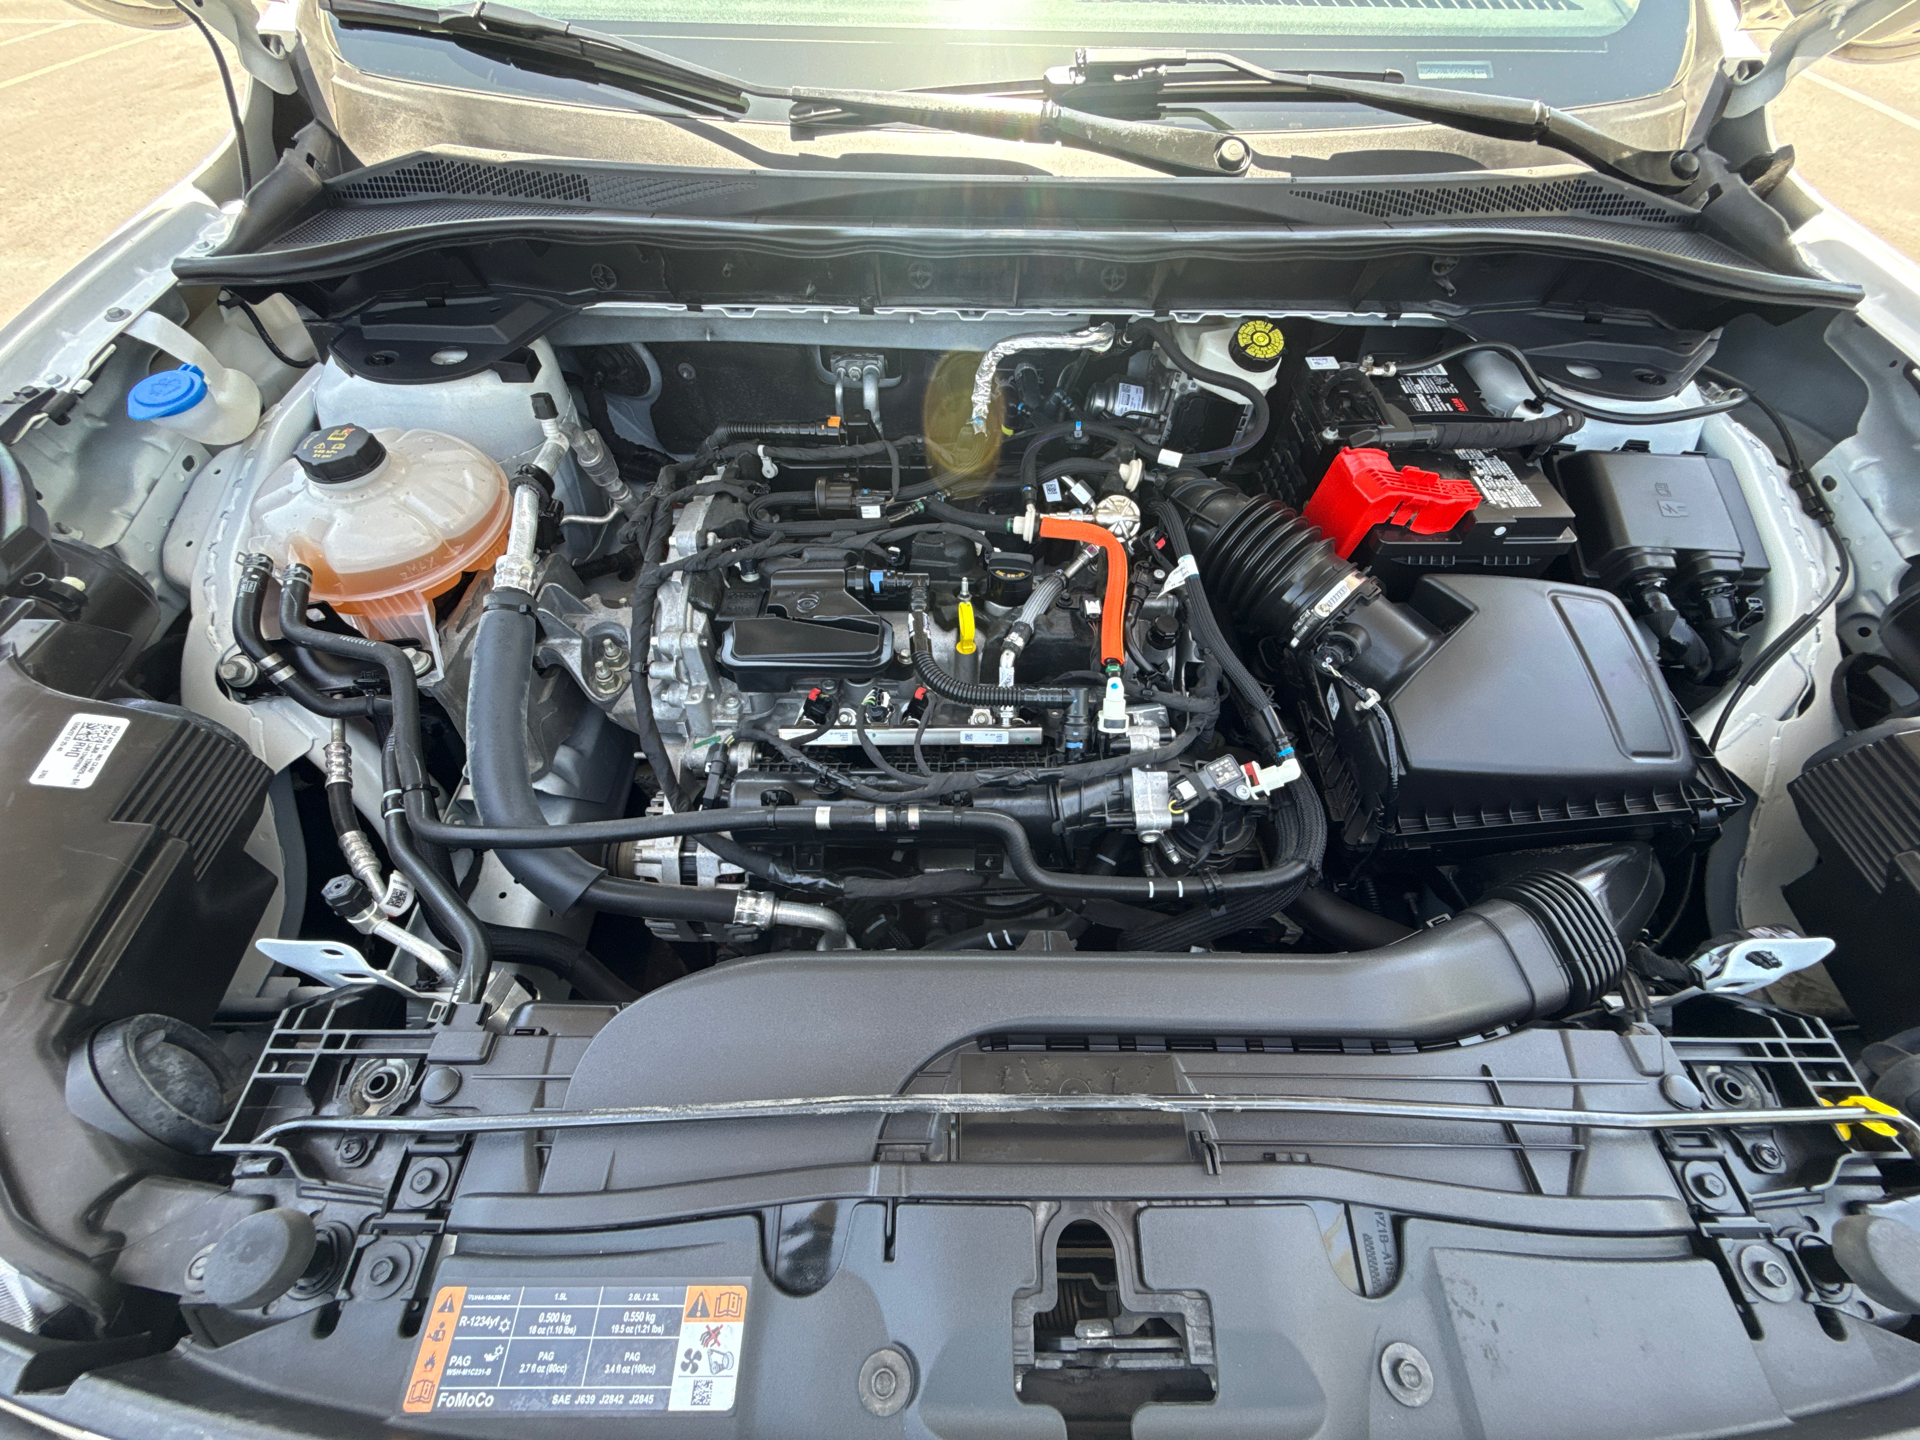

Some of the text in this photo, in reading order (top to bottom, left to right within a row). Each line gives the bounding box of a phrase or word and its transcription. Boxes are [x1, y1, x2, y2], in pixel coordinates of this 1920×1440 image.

[1451, 398, 1466, 411] AGM
[554, 1293, 568, 1301] 1.5L
[627, 1293, 642, 1301] 2.0L
[646, 1293, 660, 1301] 2.3L
[459, 1316, 500, 1328] R-1234yf
[538, 1312, 572, 1325] 0.500 kg
[623, 1311, 656, 1324] 0.550 kg
[528, 1325, 577, 1336] 18 oz (1.10 lbs)
[611, 1324, 665, 1335] 19.5 oz (1.21 lbs)
[449, 1356, 471, 1367] PAG
[537, 1351, 554, 1361] PAG
[624, 1352, 641, 1361] PAG
[519, 1364, 531, 1374] 2.7
[537, 1366, 546, 1374] oz
[604, 1364, 615, 1374] 3.4
[621, 1366, 631, 1374] oz
[631, 1363, 656, 1375] (100cc)
[437, 1392, 495, 1407] FoMoCo
[552, 1394, 654, 1405] SAE J639 J2842 J2845
